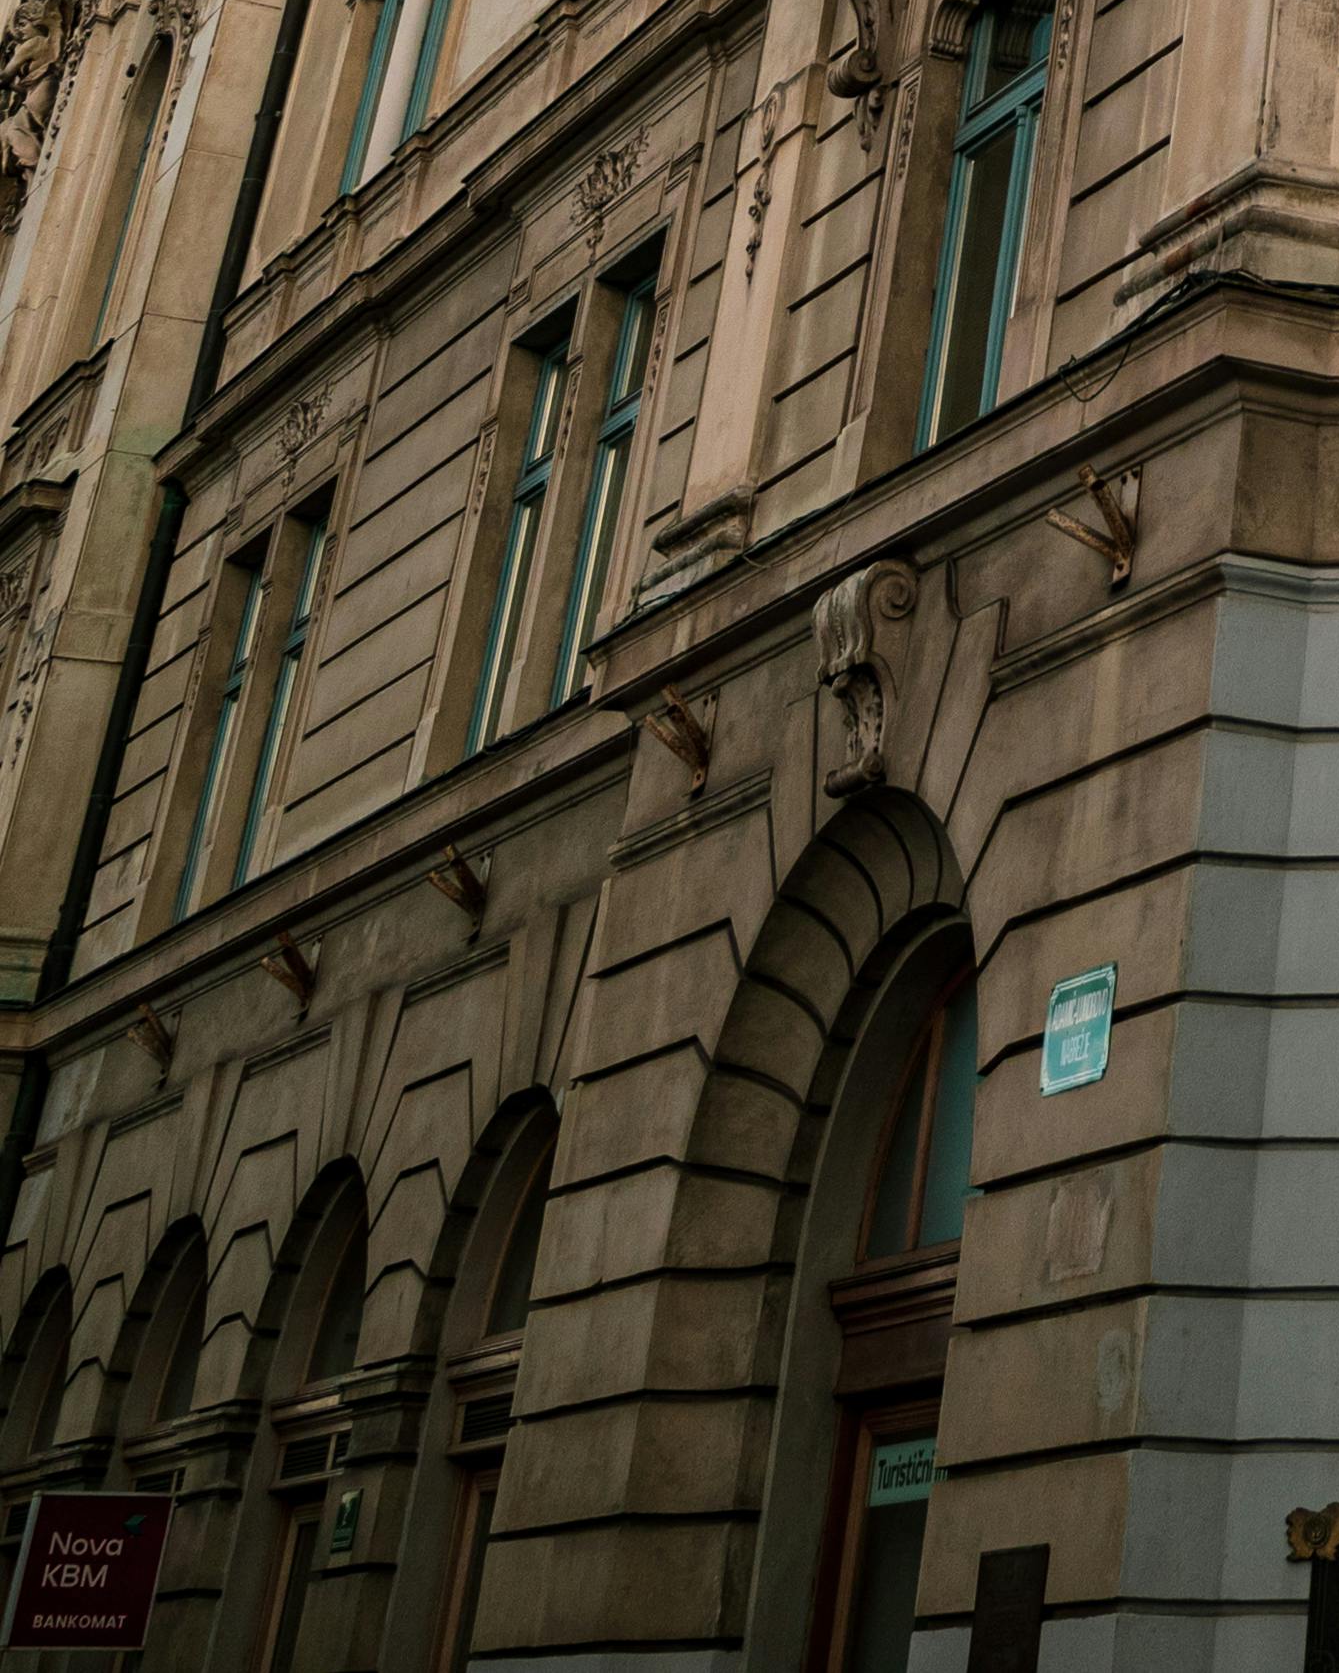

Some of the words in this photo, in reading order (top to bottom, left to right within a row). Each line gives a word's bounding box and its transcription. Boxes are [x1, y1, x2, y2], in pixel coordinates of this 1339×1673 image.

[48, 1531, 125, 1557] Nova
[41, 1562, 110, 1589] KBM
[32, 1613, 129, 1630] BANKOMAT
